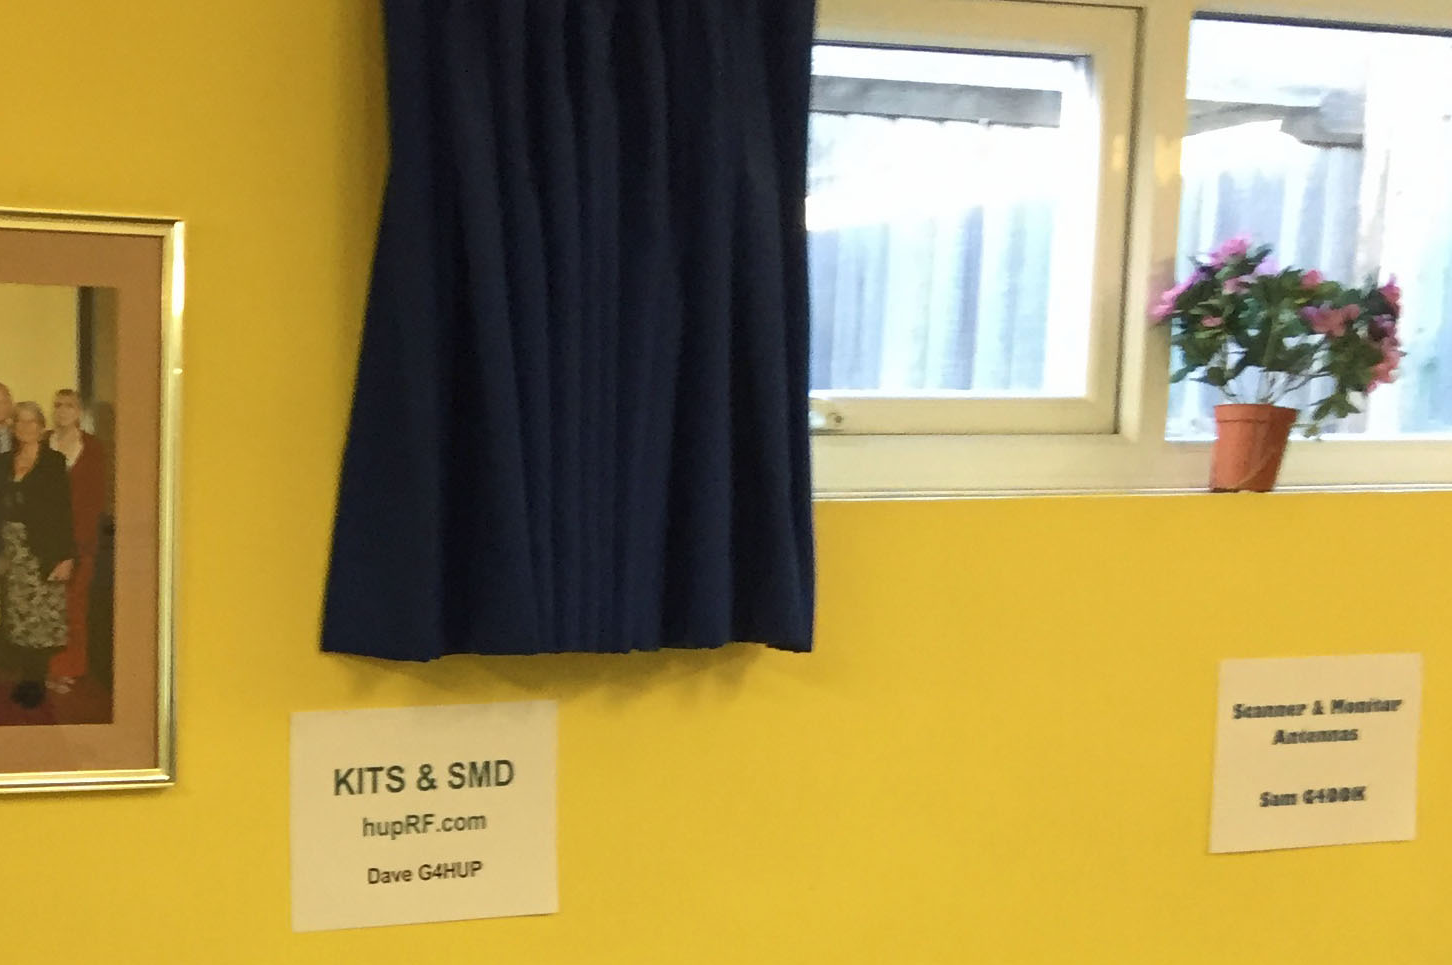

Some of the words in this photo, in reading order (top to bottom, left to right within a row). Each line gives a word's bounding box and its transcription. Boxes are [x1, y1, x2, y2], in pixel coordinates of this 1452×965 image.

[1233, 702, 1307, 719] Scanner
[1312, 700, 1324, 715] &
[1330, 699, 1403, 714] Monitor
[1272, 728, 1359, 745] Antennas
[334, 765, 406, 796] KITS
[416, 763, 438, 792] &
[447, 759, 514, 790] SMD
[362, 813, 487, 840] hupRF.com
[367, 867, 413, 884] Dave
[418, 861, 483, 881] G4HUP
